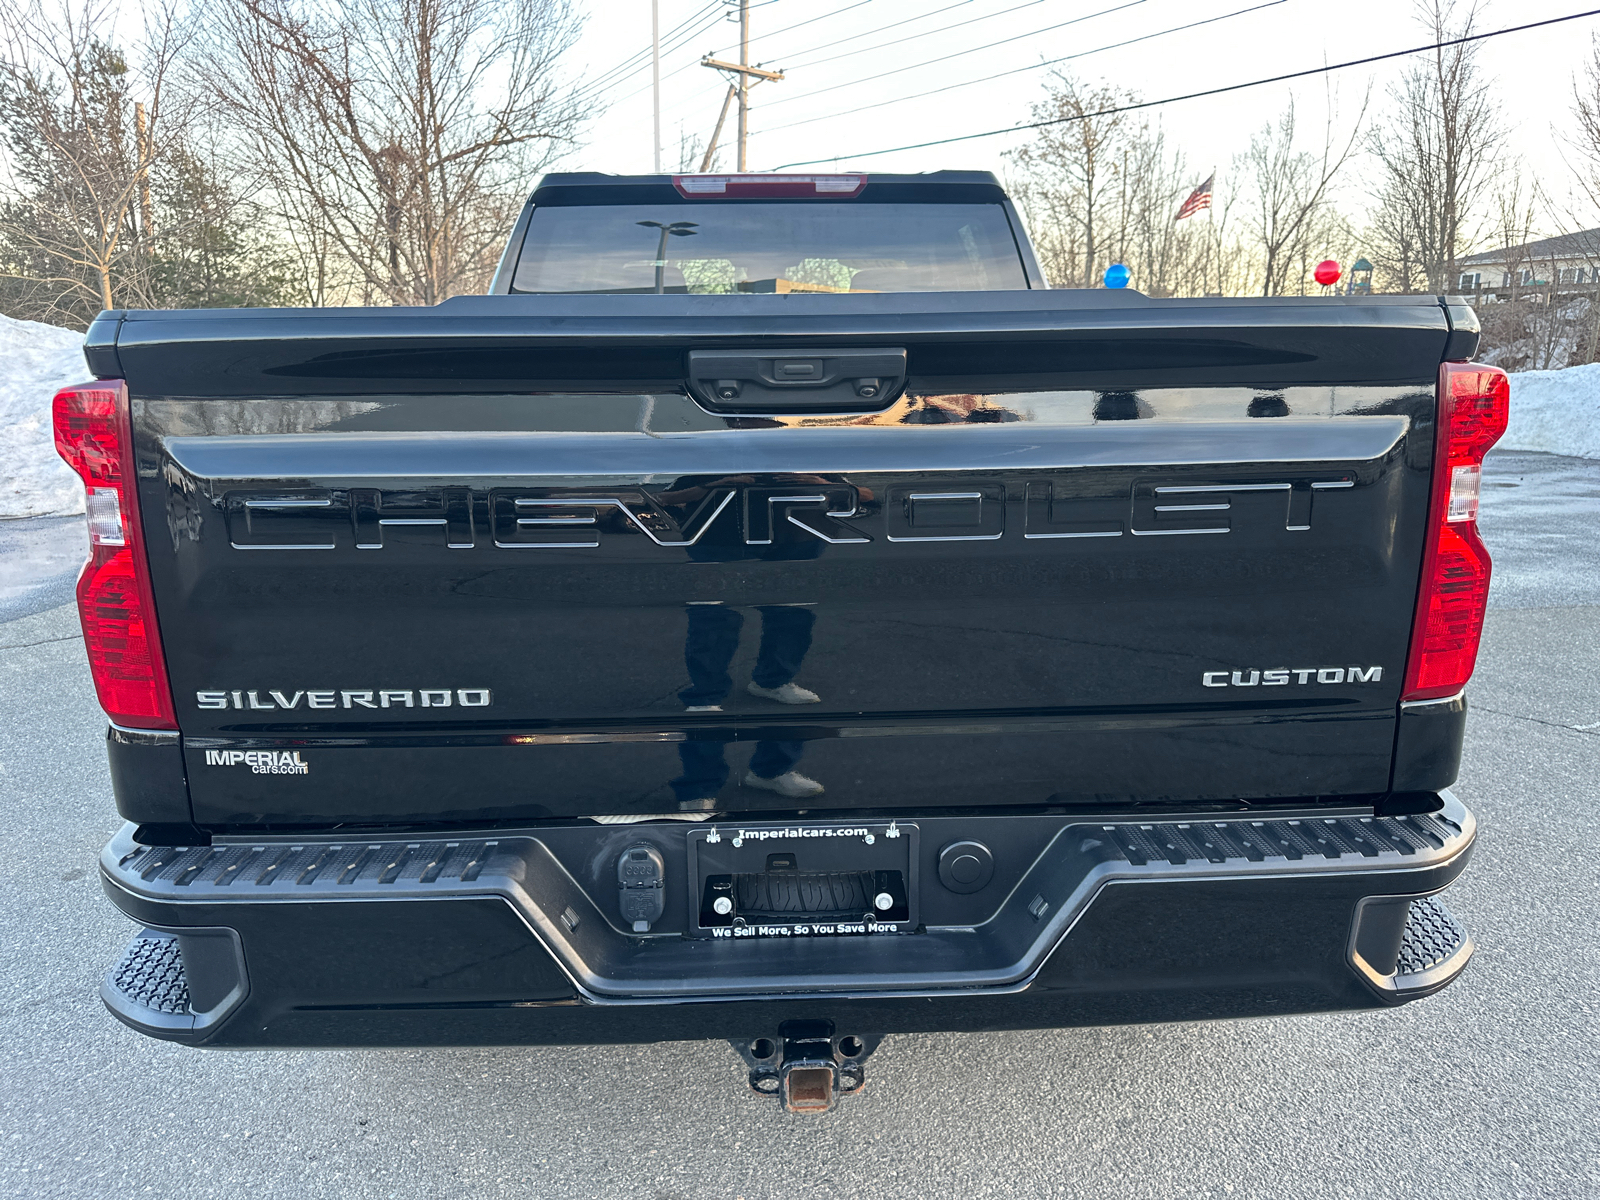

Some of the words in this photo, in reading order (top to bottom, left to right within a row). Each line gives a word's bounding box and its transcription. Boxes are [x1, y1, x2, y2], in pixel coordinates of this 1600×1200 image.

[226, 471, 1357, 550] CHEVROLET
[1202, 666, 1382, 687] CUSTOM
[196, 688, 491, 709] SILVERADO
[205, 749, 308, 766] IMPERIAL
[251, 764, 309, 775] cars.com
[738, 828, 868, 841] Imperialcars.com
[712, 927, 732, 938] We
[733, 926, 756, 937] Sell
[758, 925, 791, 937] More,
[793, 924, 811, 935] So
[812, 924, 835, 935] You
[836, 923, 866, 934] Save
[867, 922, 898, 933] More
